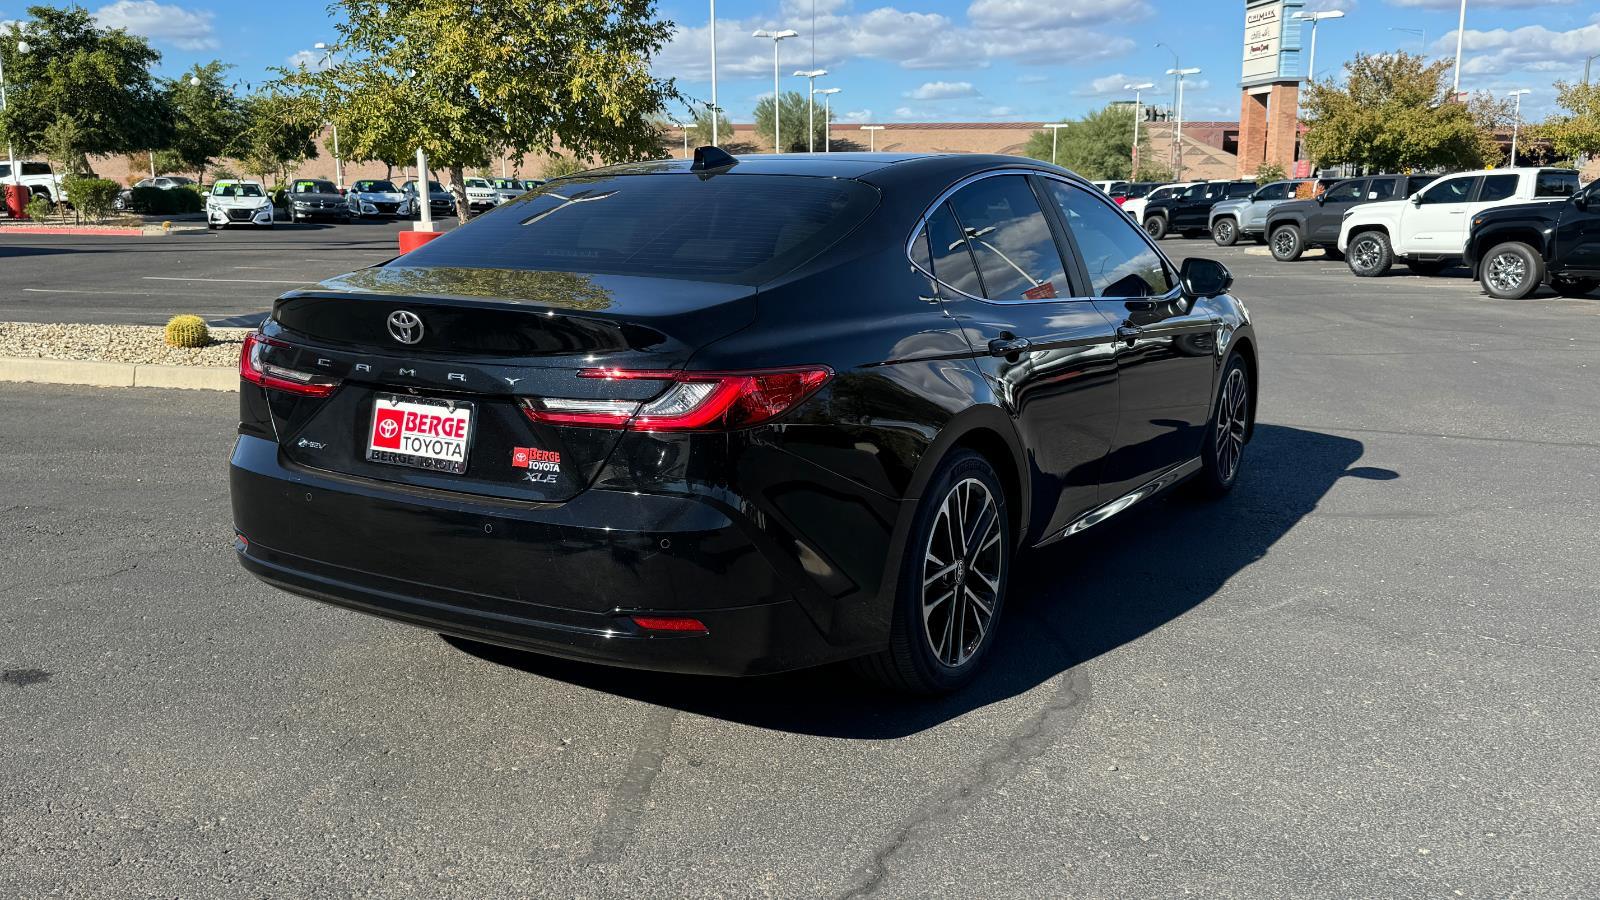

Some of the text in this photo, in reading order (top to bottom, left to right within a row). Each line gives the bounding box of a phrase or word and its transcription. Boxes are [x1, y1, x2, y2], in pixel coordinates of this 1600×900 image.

[318, 358, 525, 386] CAMRY
[404, 411, 466, 437] BERGE
[403, 436, 462, 457] TOYOTA
[371, 451, 415, 464] BERGE
[529, 447, 561, 463] BERGE
[528, 461, 560, 472] TOYOTA
[522, 472, 558, 483] XLE
